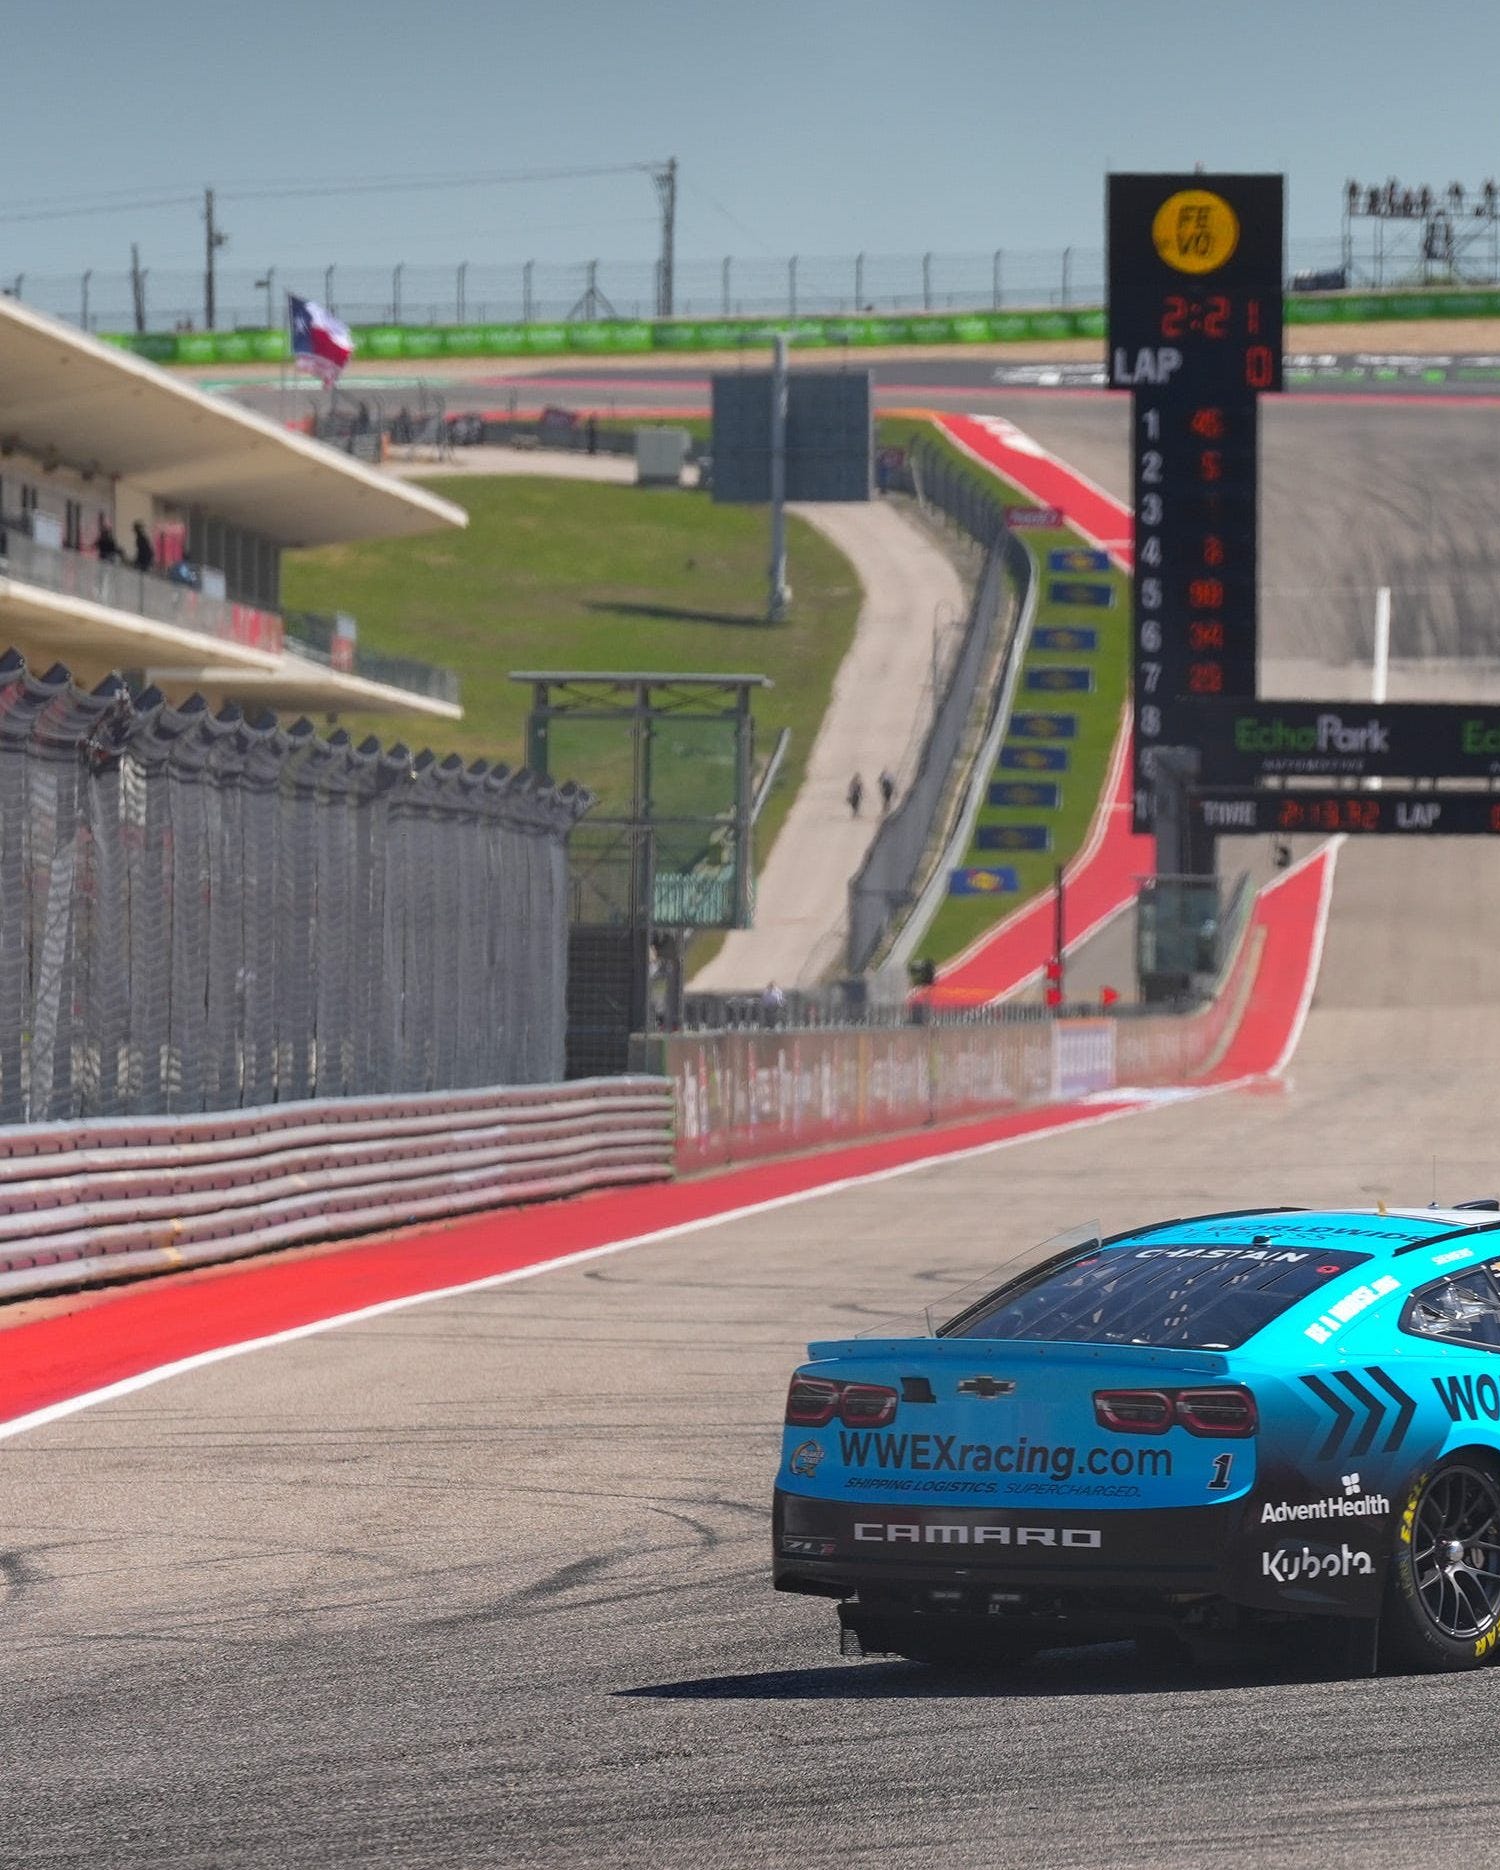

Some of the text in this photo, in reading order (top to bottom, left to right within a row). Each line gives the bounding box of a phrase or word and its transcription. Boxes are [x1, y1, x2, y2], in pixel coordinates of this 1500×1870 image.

[1113, 347, 1184, 385] LAP
[1142, 407, 1160, 441] 1
[1141, 451, 1162, 483] 2
[1141, 493, 1162, 525] 3
[1140, 536, 1162, 568] 4
[1141, 577, 1162, 609] 5
[1141, 619, 1162, 652] 6
[1140, 661, 1162, 693] 7
[1140, 704, 1162, 737] 8
[1234, 713, 1391, 754] EchoPark
[1396, 802, 1441, 829] LAP
[838, 1430, 1173, 1481] WWEXracing.com
[843, 1476, 913, 1492] SHIPPING
[1207, 1453, 1235, 1491] 1
[1260, 1494, 1391, 1523] AdventHealth
[853, 1522, 1101, 1548] CAMARO
[1262, 1543, 1375, 1582] Kubota
